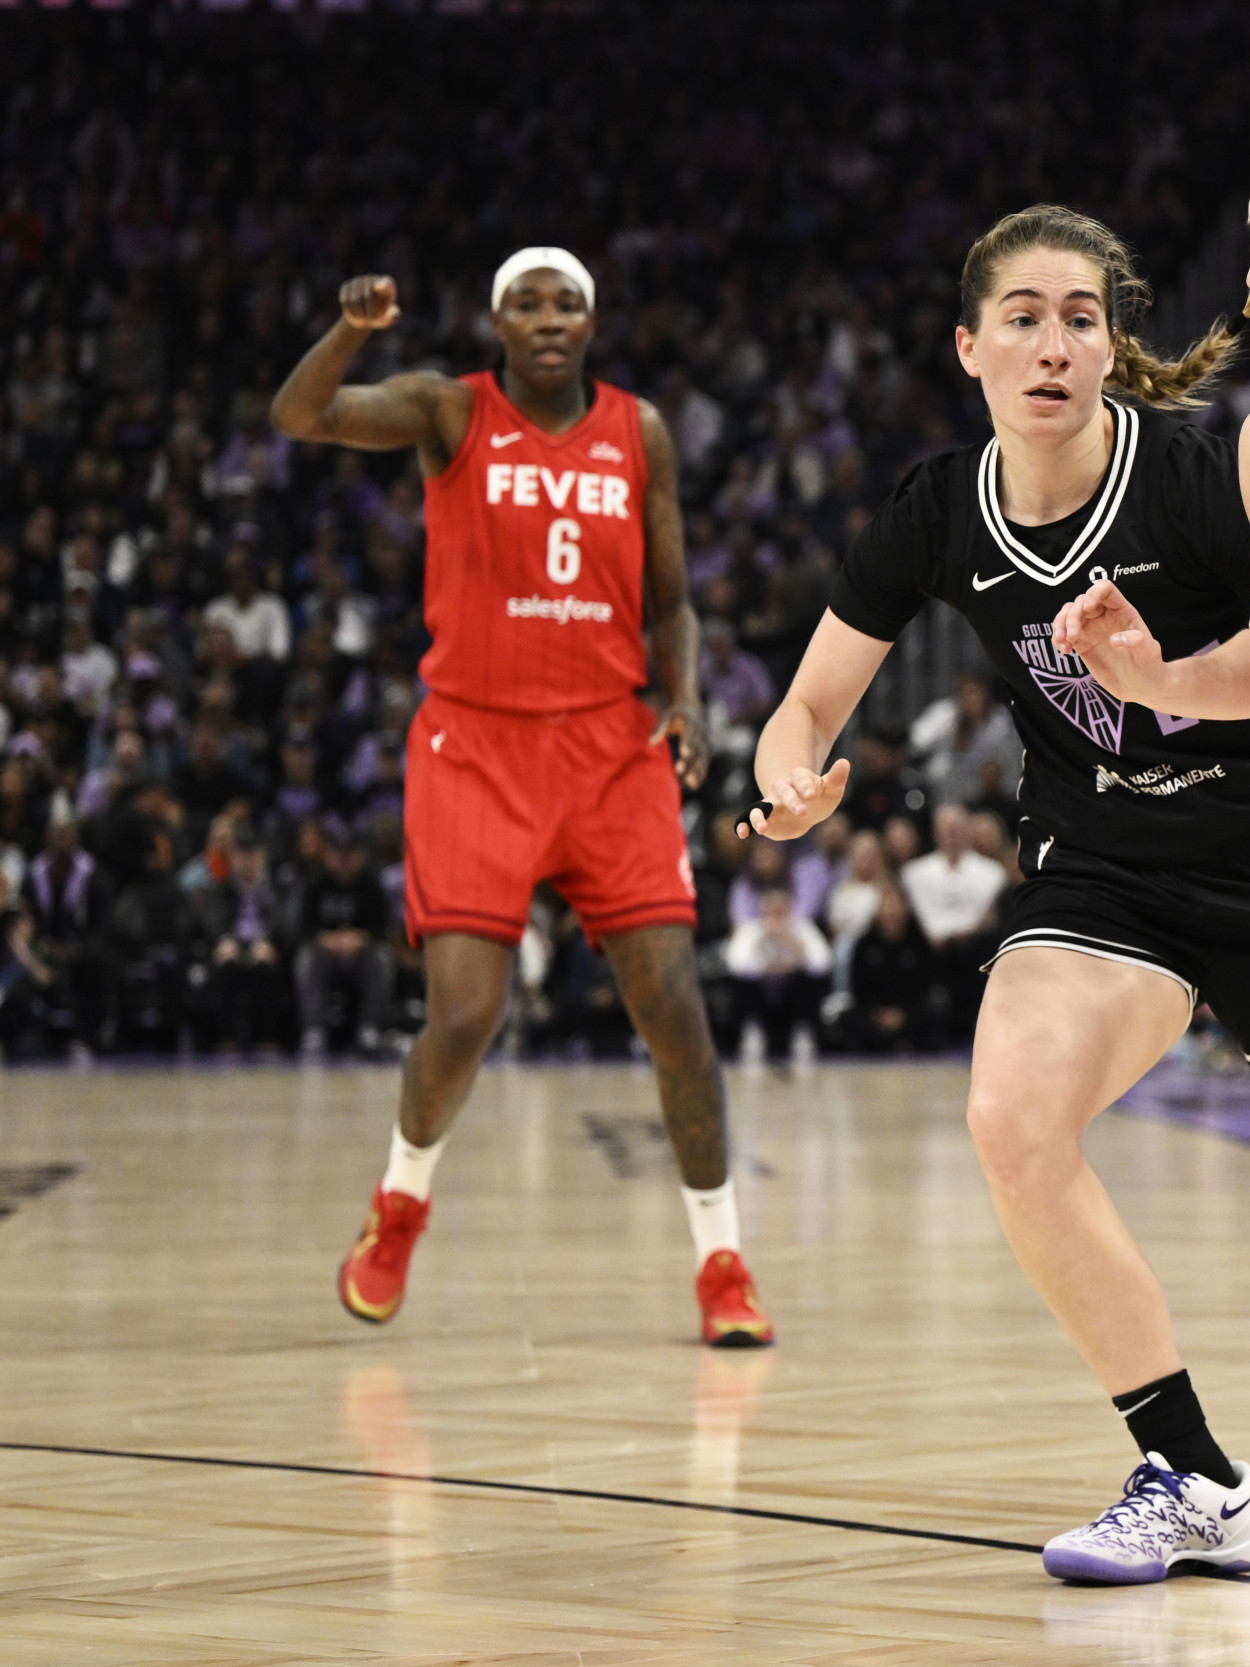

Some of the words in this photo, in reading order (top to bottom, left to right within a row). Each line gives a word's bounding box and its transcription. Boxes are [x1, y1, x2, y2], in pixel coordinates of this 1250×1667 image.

[486, 463, 630, 520] FEVER
[545, 517, 582, 586] 6
[1112, 561, 1160, 582] freedom
[506, 594, 613, 626] salesforce
[1022, 622, 1054, 638] GOLD
